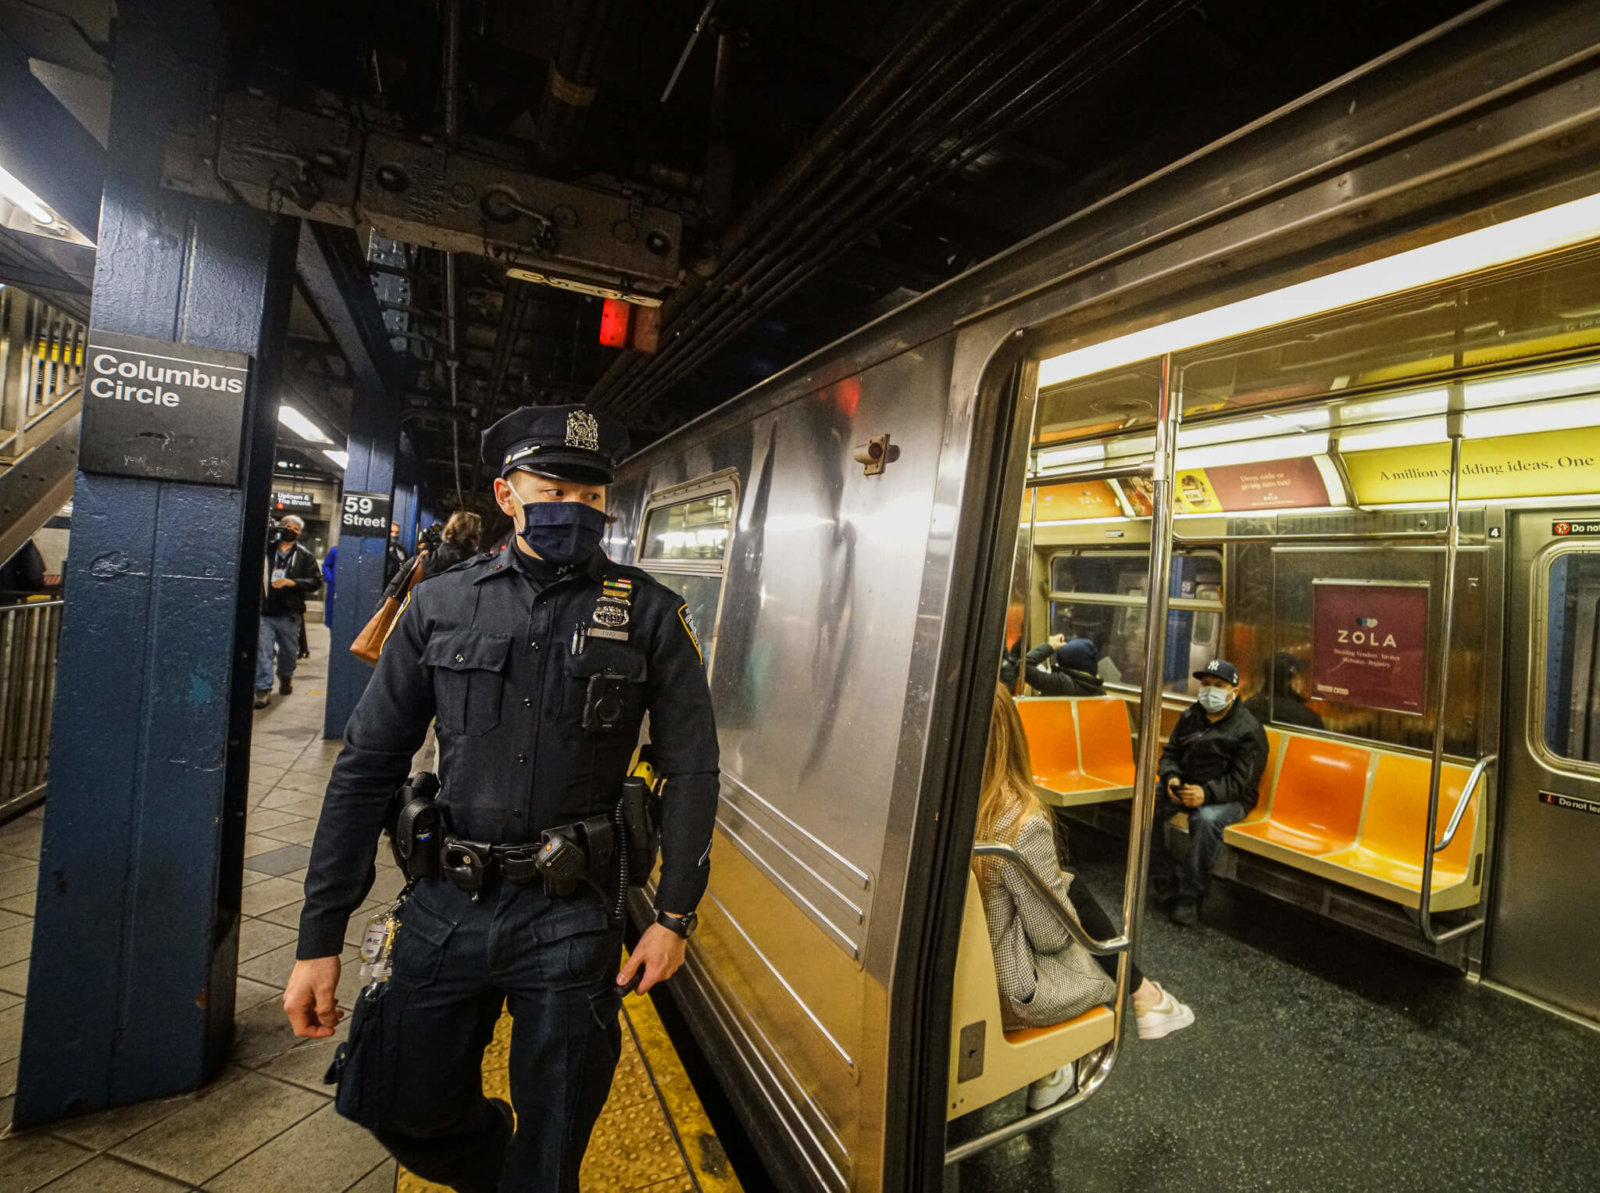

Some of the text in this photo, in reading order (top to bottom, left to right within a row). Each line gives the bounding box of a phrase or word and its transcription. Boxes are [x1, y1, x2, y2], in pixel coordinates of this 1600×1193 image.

[93, 354, 243, 394] Columbus
[90, 378, 180, 408] Circle
[1379, 455, 1595, 481] A million wdding ideas. One
[344, 496, 373, 514] 59
[343, 513, 386, 528] Street
[1572, 524, 1585, 532] Do
[1490, 530, 1499, 538] 4
[1337, 629, 1397, 648] ZOLA
[1559, 798, 1571, 806] Do
[1573, 802, 1587, 810] not
